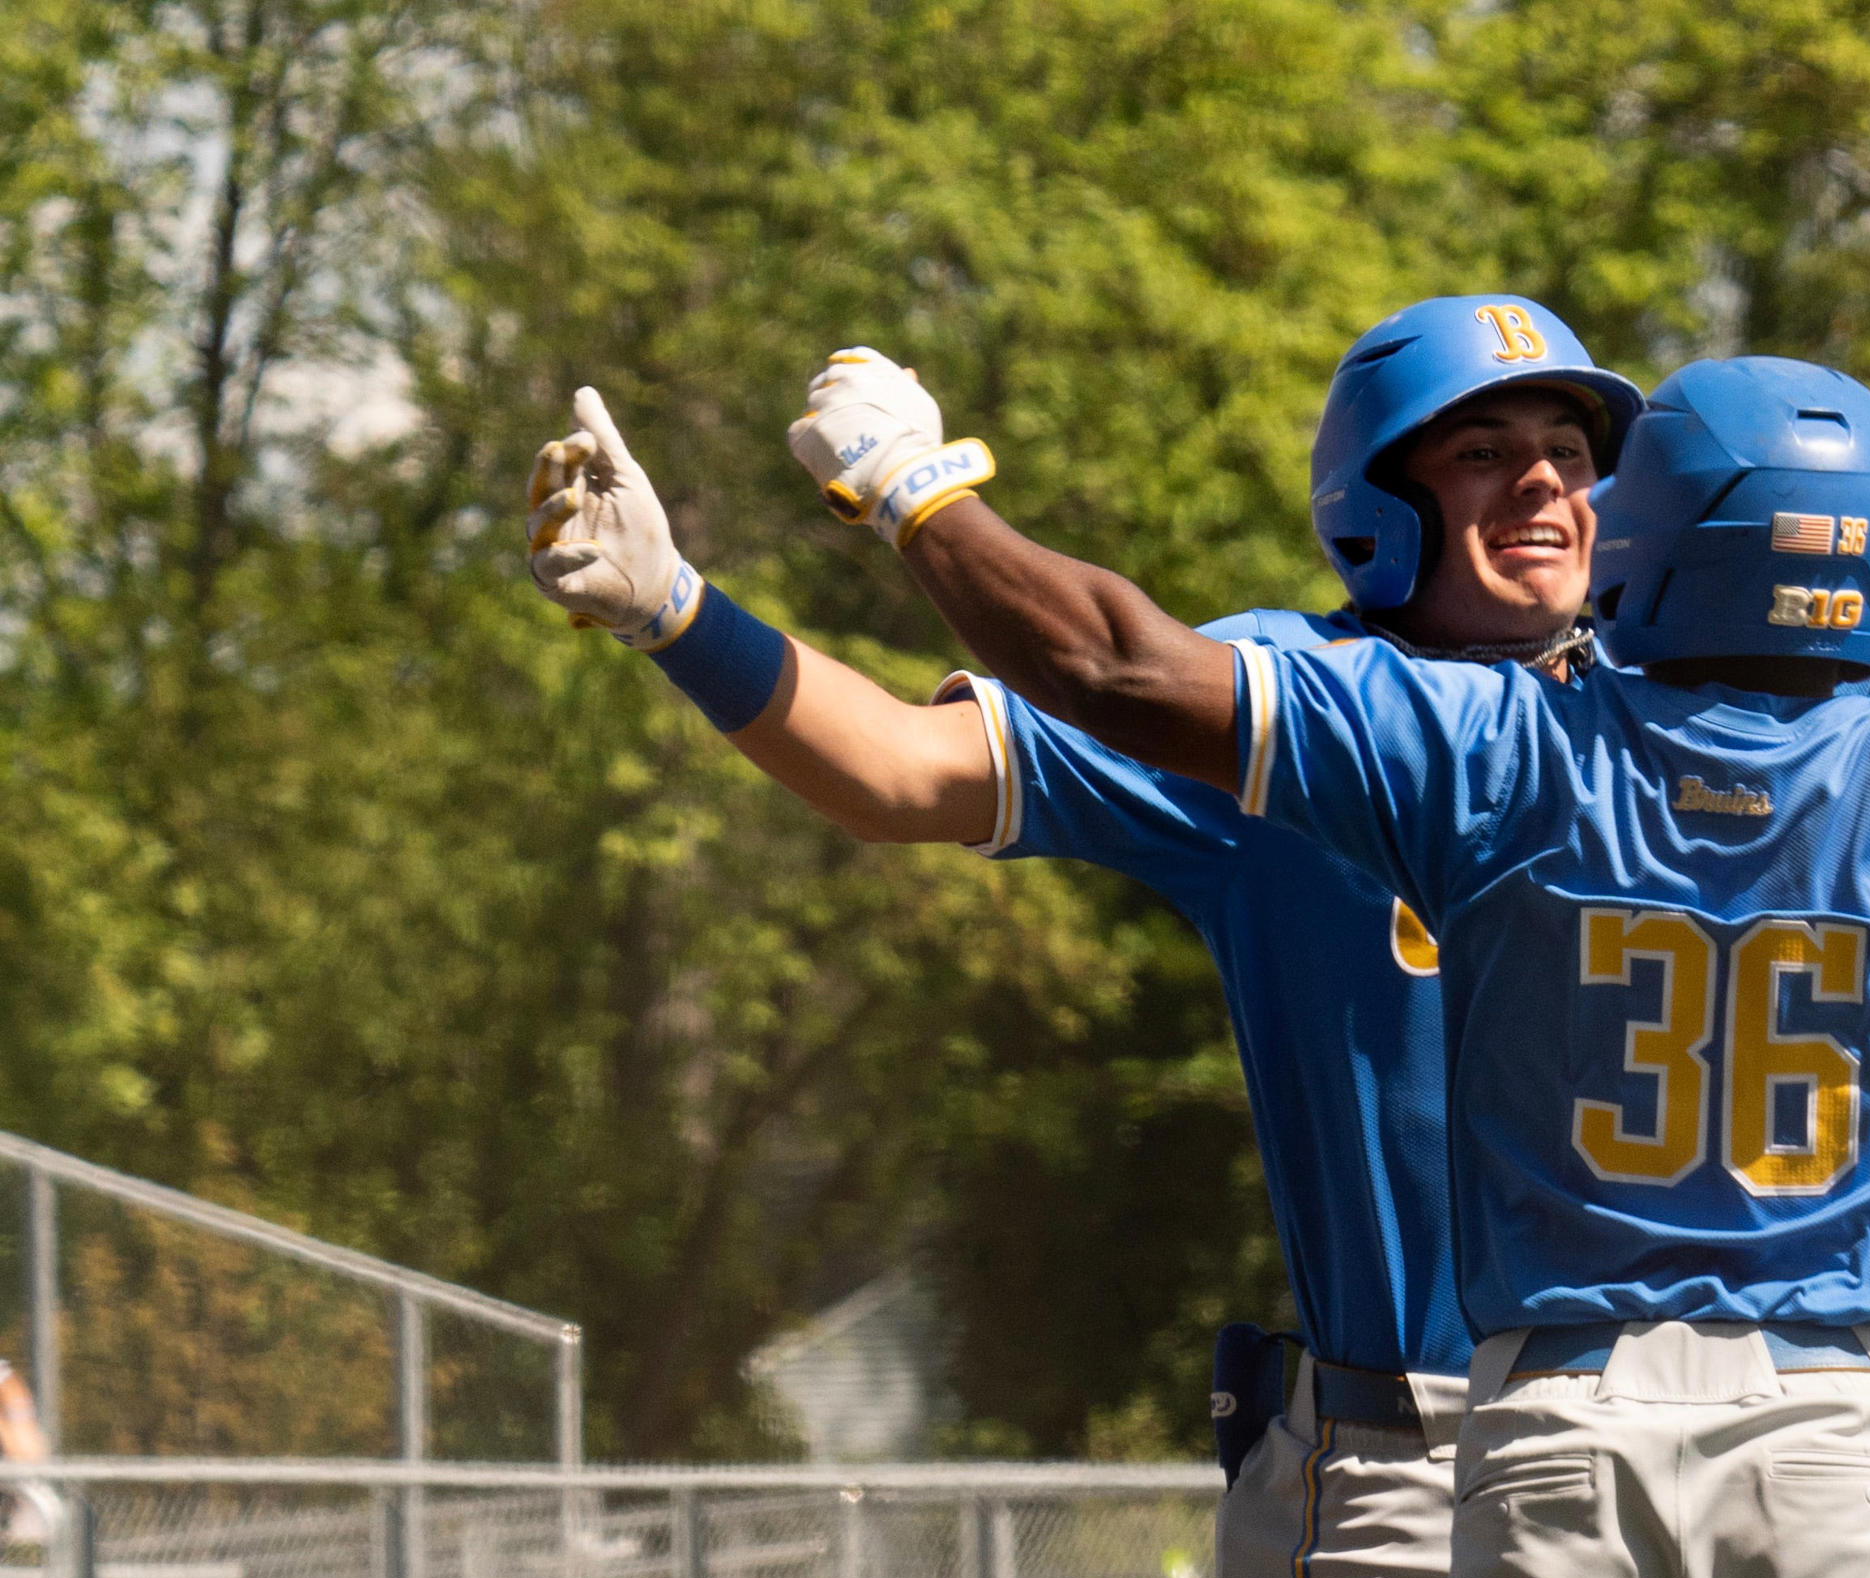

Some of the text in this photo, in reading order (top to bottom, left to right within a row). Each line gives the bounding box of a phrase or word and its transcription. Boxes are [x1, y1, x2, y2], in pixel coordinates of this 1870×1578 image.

[1473, 304, 1548, 364] B
[877, 452, 972, 536] TON
[1837, 515, 1869, 556] 36
[1672, 774, 1773, 816] Bruins
[1571, 906, 1868, 1197] 36
